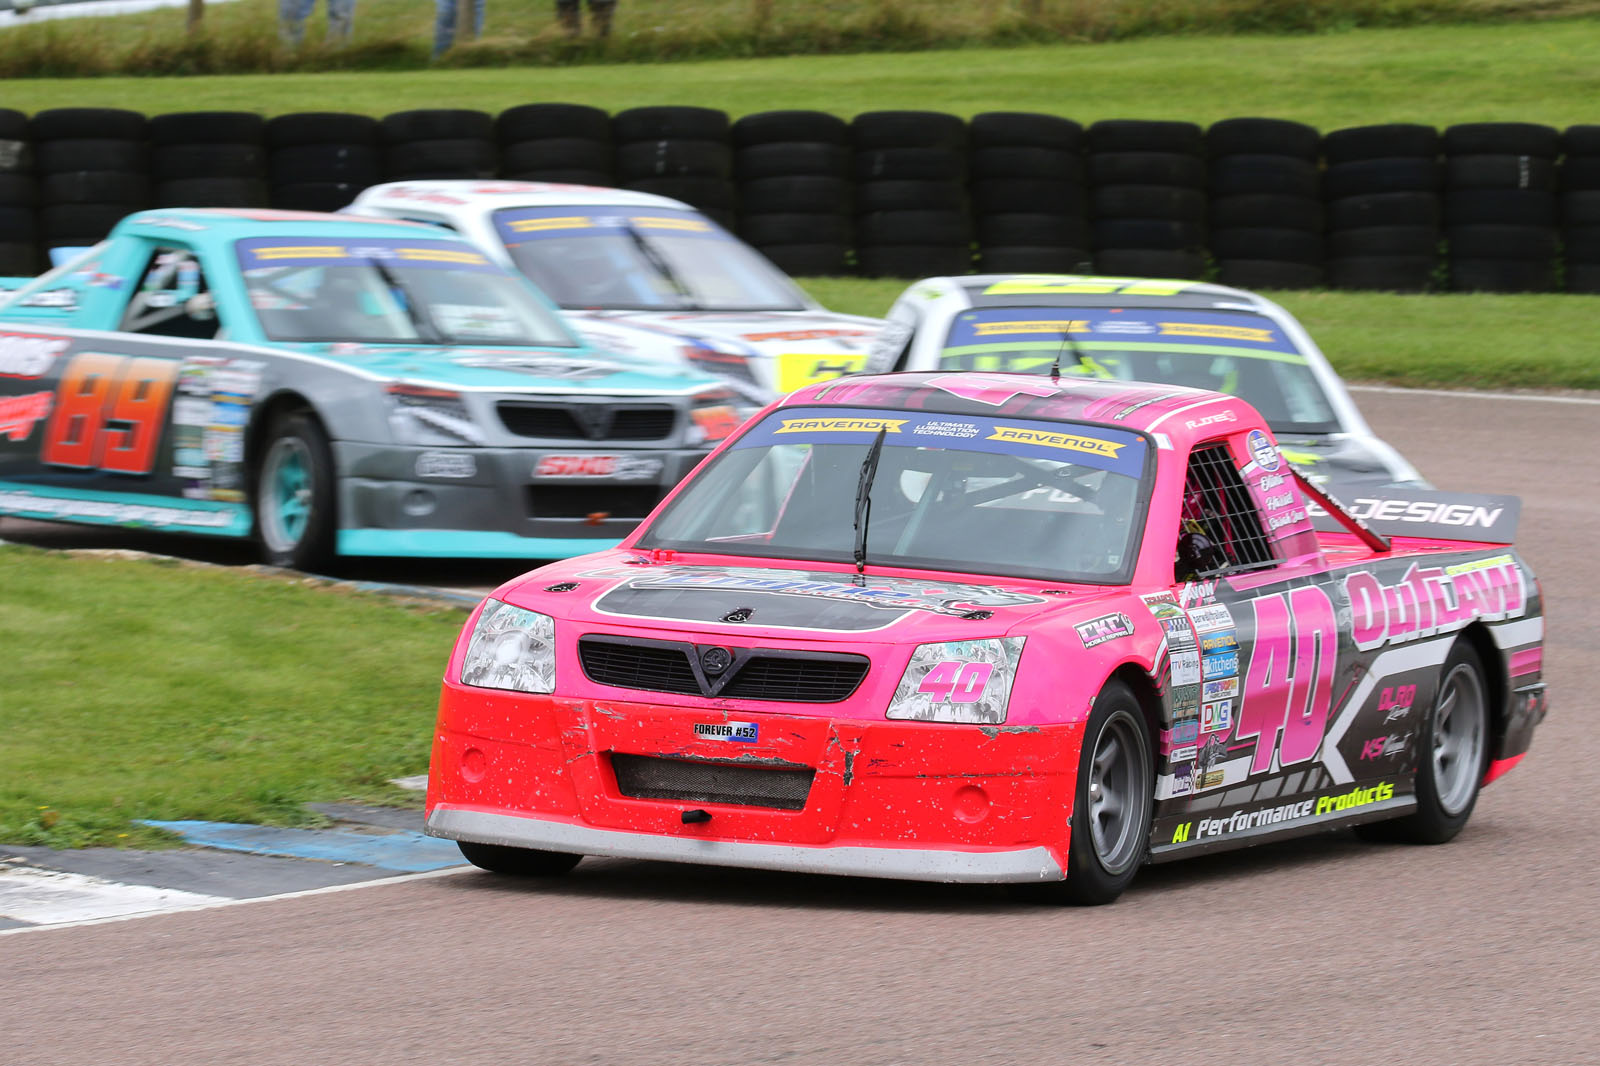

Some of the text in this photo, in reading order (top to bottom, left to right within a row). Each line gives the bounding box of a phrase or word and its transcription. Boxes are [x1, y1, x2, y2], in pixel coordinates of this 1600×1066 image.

[788, 420, 894, 430] RAVENOL
[912, 429, 978, 439] TECHNOLOGY
[915, 424, 981, 434] LUBRICATION
[926, 420, 976, 430] ULTIMATE
[1000, 430, 1110, 453] RAVENOL
[1179, 581, 1215, 609] AVON
[1203, 635, 1237, 651] RAVENOL
[917, 661, 995, 704] 40
[1234, 584, 1339, 776] 40
[1204, 701, 1229, 725] DWG
[693, 723, 756, 738] FOREVER #52
[1196, 798, 1316, 840] Performance
[1315, 781, 1396, 816] Products
